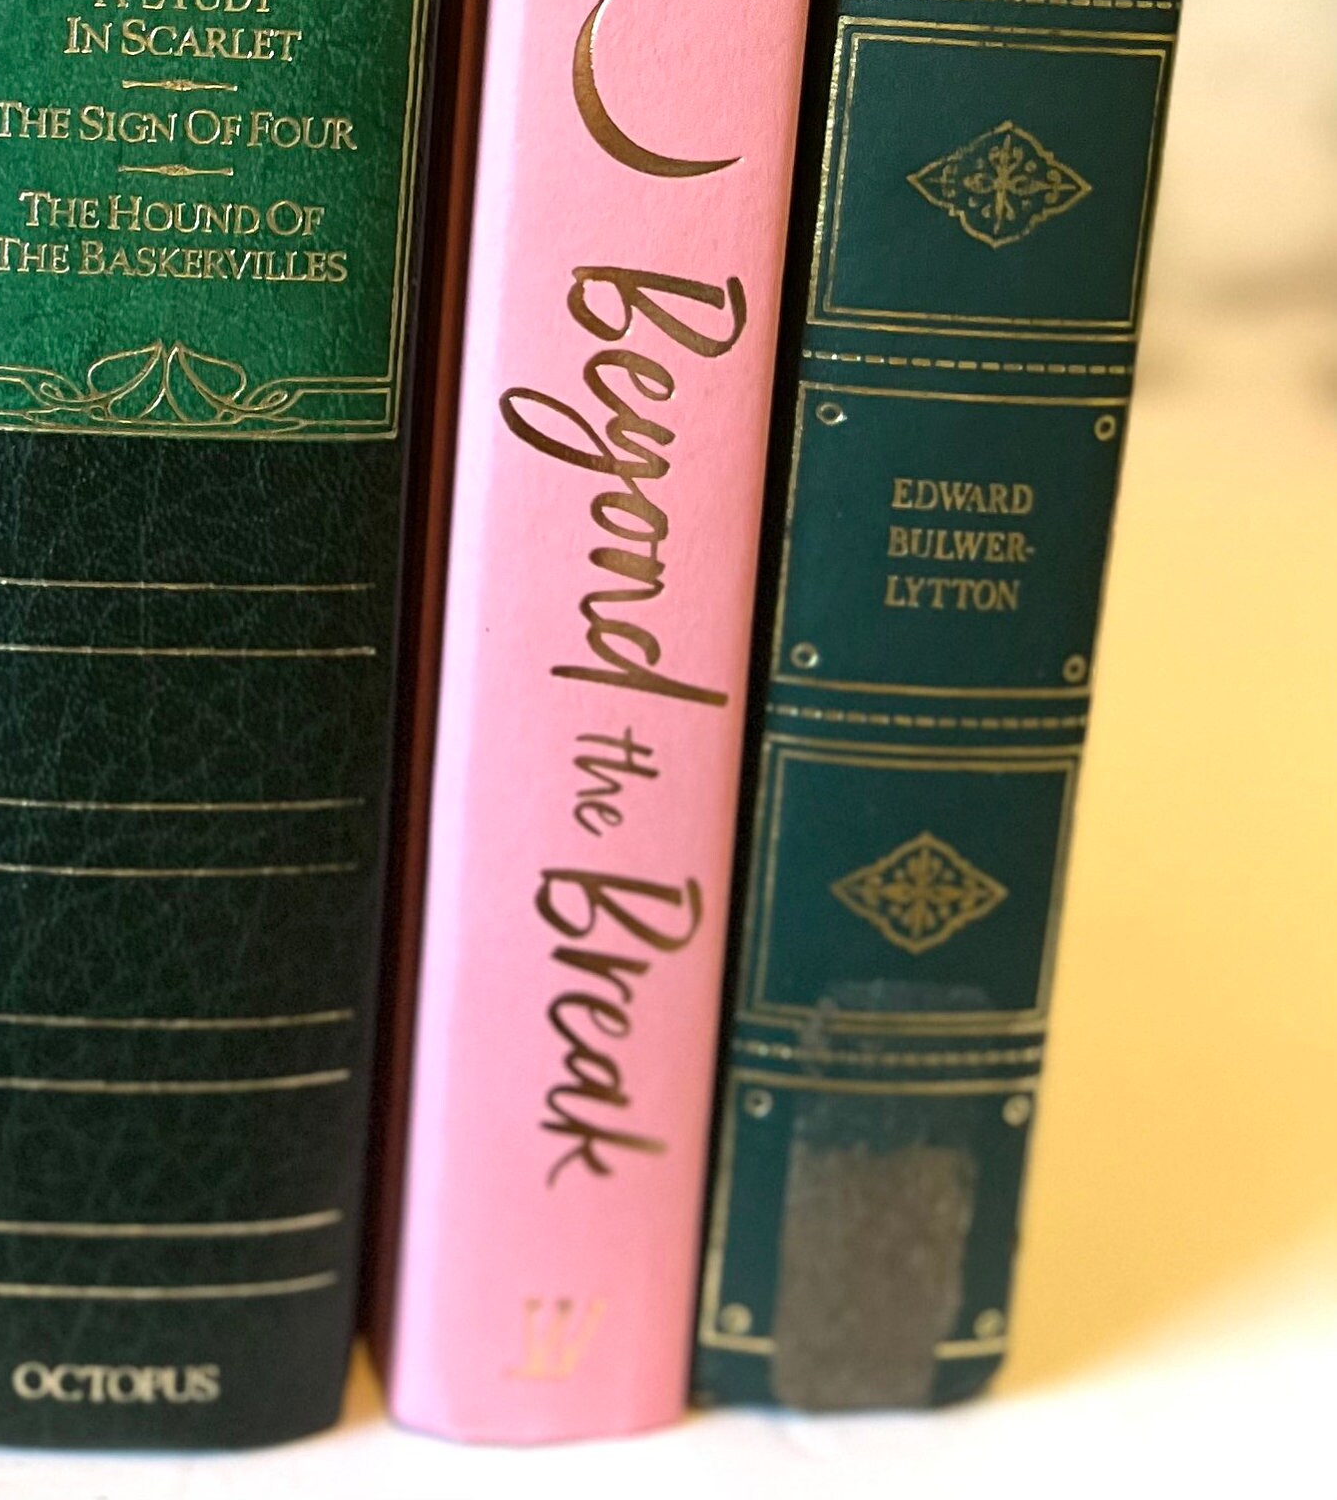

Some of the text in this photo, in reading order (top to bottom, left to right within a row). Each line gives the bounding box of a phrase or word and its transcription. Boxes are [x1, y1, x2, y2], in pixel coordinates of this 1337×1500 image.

[64, 16, 303, 63] IN SCARLET
[78, 105, 178, 144] SIGN
[186, 109, 242, 147] OF
[247, 111, 358, 151] FOUR
[18, 190, 326, 238] THE HOUND OF
[77, 238, 348, 283] BASKERVILLES
[498, 264, 748, 708] Beyond
[891, 477, 1034, 515] EDWARD
[886, 525, 1035, 563] BULWER-
[883, 574, 1021, 612] LYTTON
[573, 726, 660, 839] the
[534, 864, 704, 1187] Break
[11, 1360, 221, 1403] OCTOPUS
